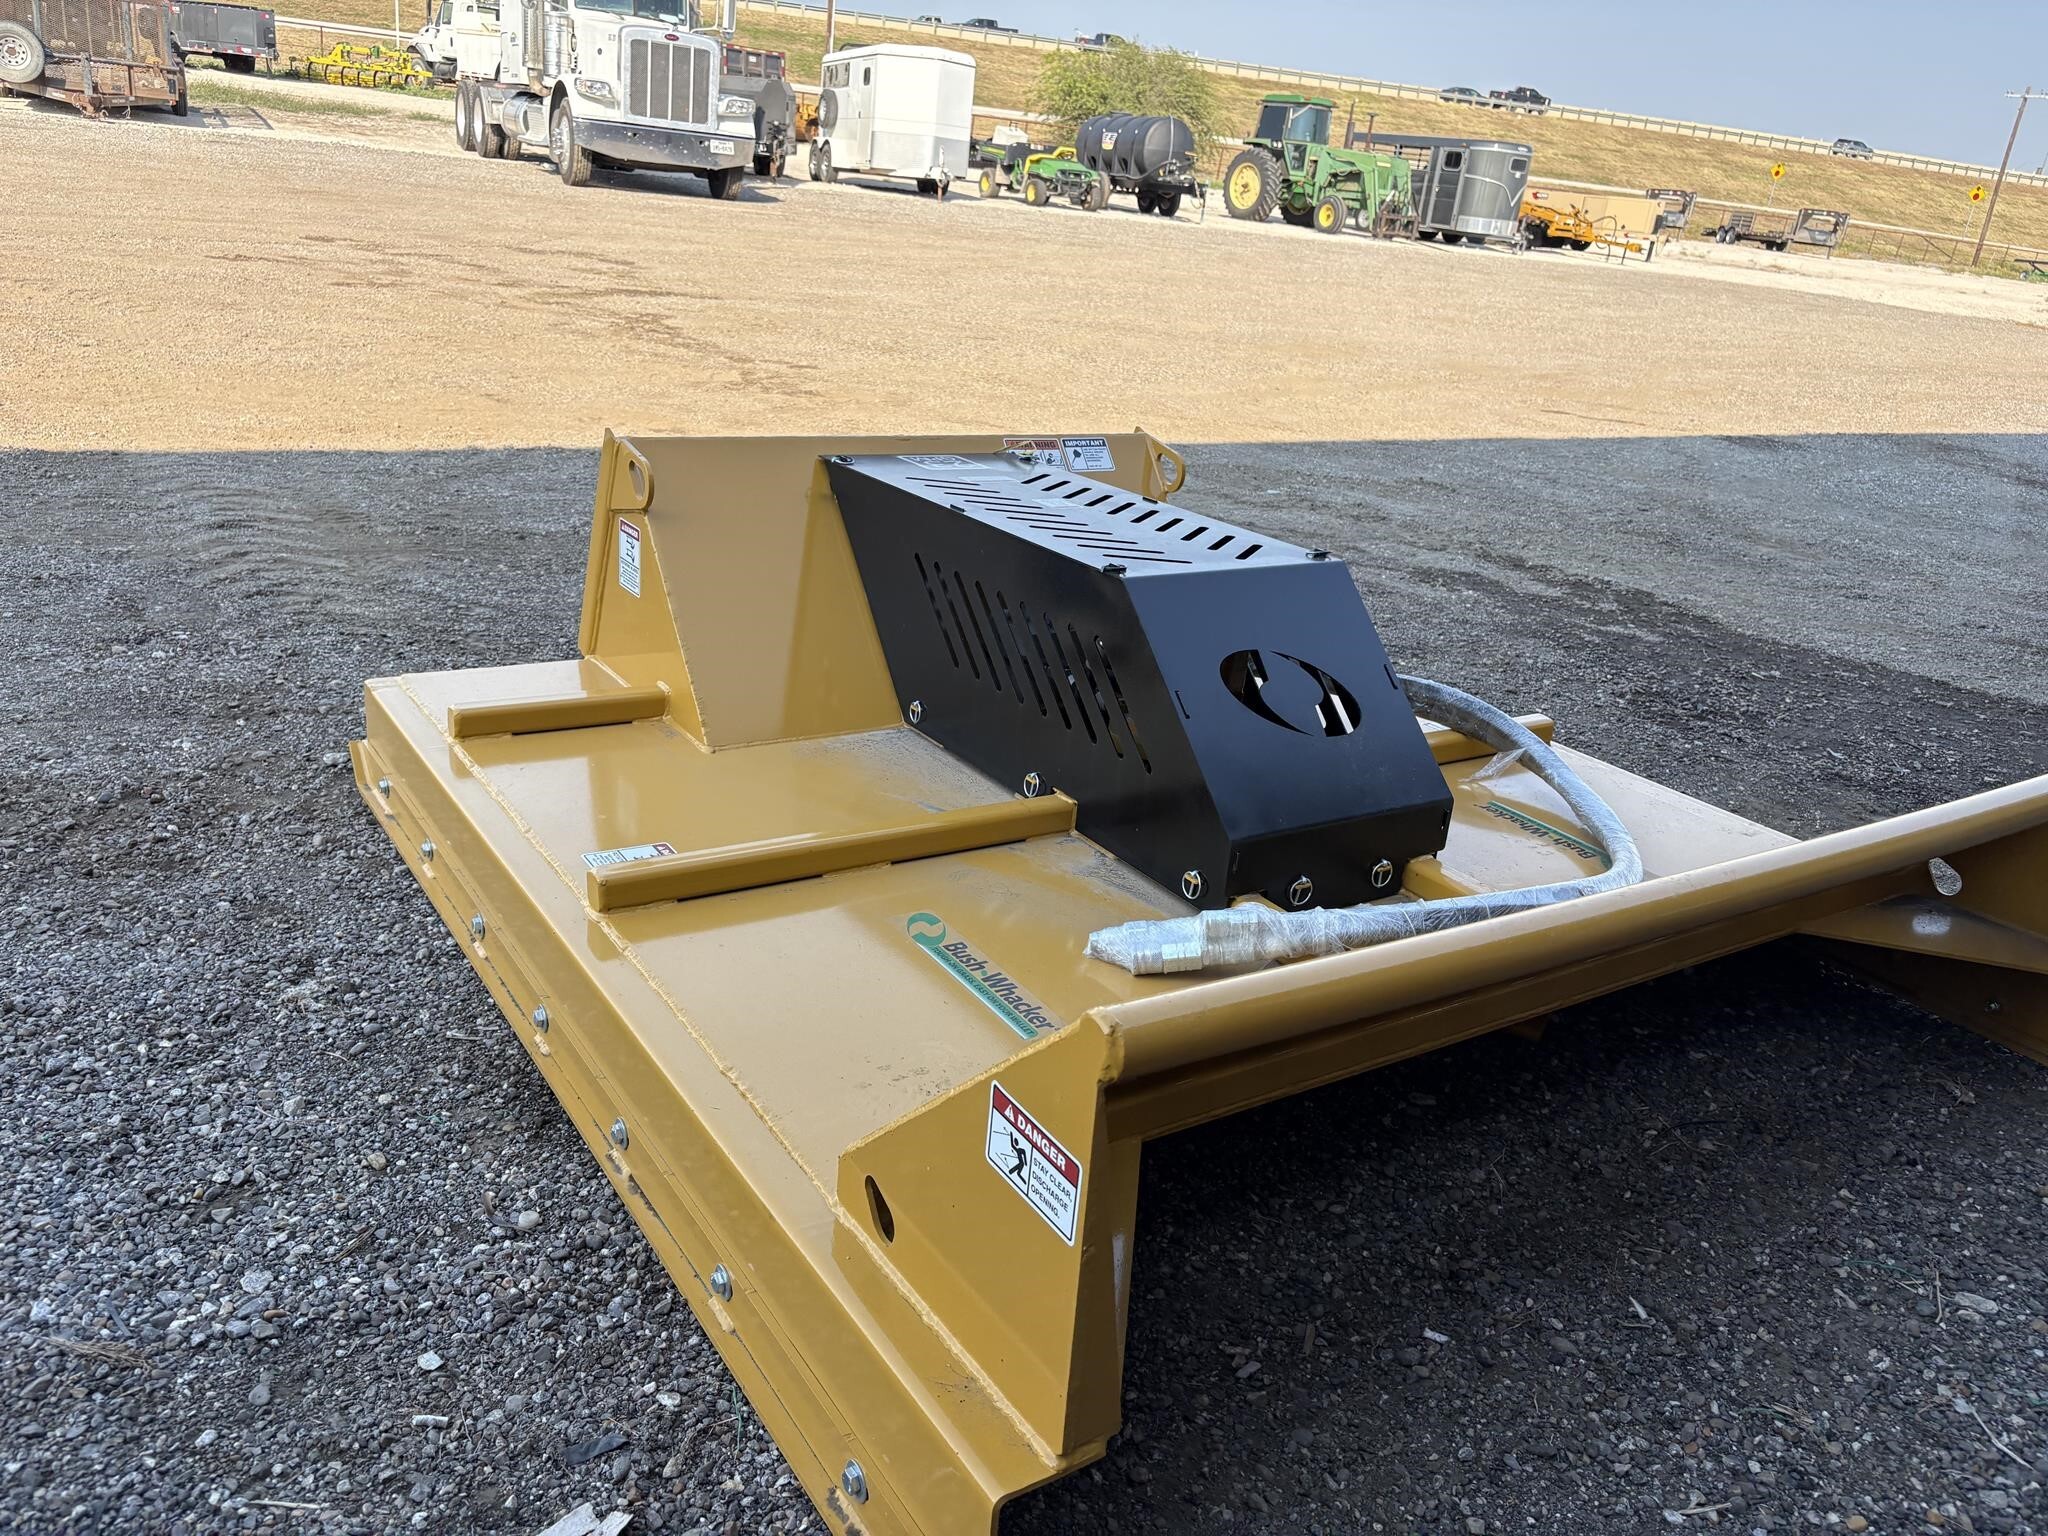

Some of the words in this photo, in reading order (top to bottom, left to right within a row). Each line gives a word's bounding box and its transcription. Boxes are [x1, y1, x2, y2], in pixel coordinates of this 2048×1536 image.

[942, 941, 989, 972] Bush
[981, 971, 1055, 1029] Whacker
[1017, 1113, 1066, 1172] DANGER
[1033, 1157, 1050, 1177] STAY
[1031, 1170, 1069, 1213] DISCHARGE
